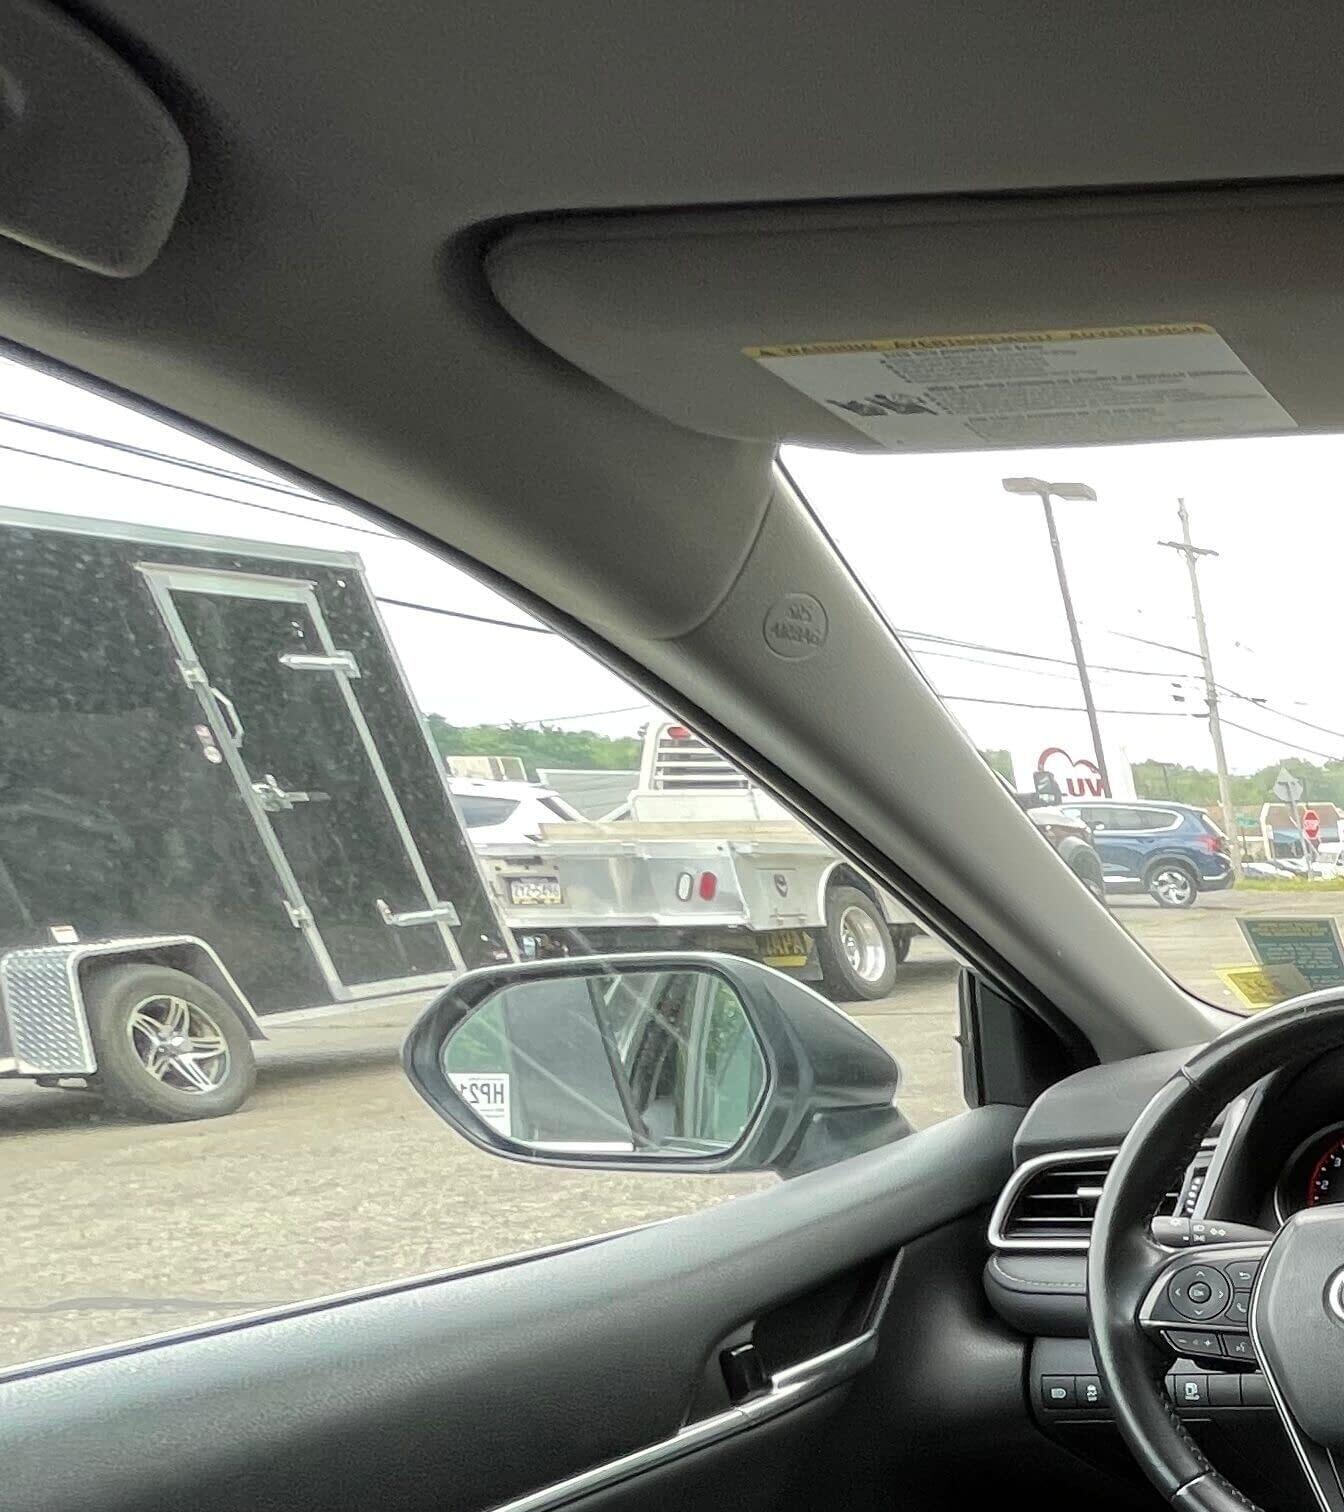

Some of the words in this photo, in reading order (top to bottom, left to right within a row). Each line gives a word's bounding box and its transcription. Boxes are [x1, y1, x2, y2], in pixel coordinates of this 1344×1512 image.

[1061, 778, 1104, 797] UV
[1334, 1157, 1342, 1168] 3
[1320, 1180, 1329, 1190] 2
